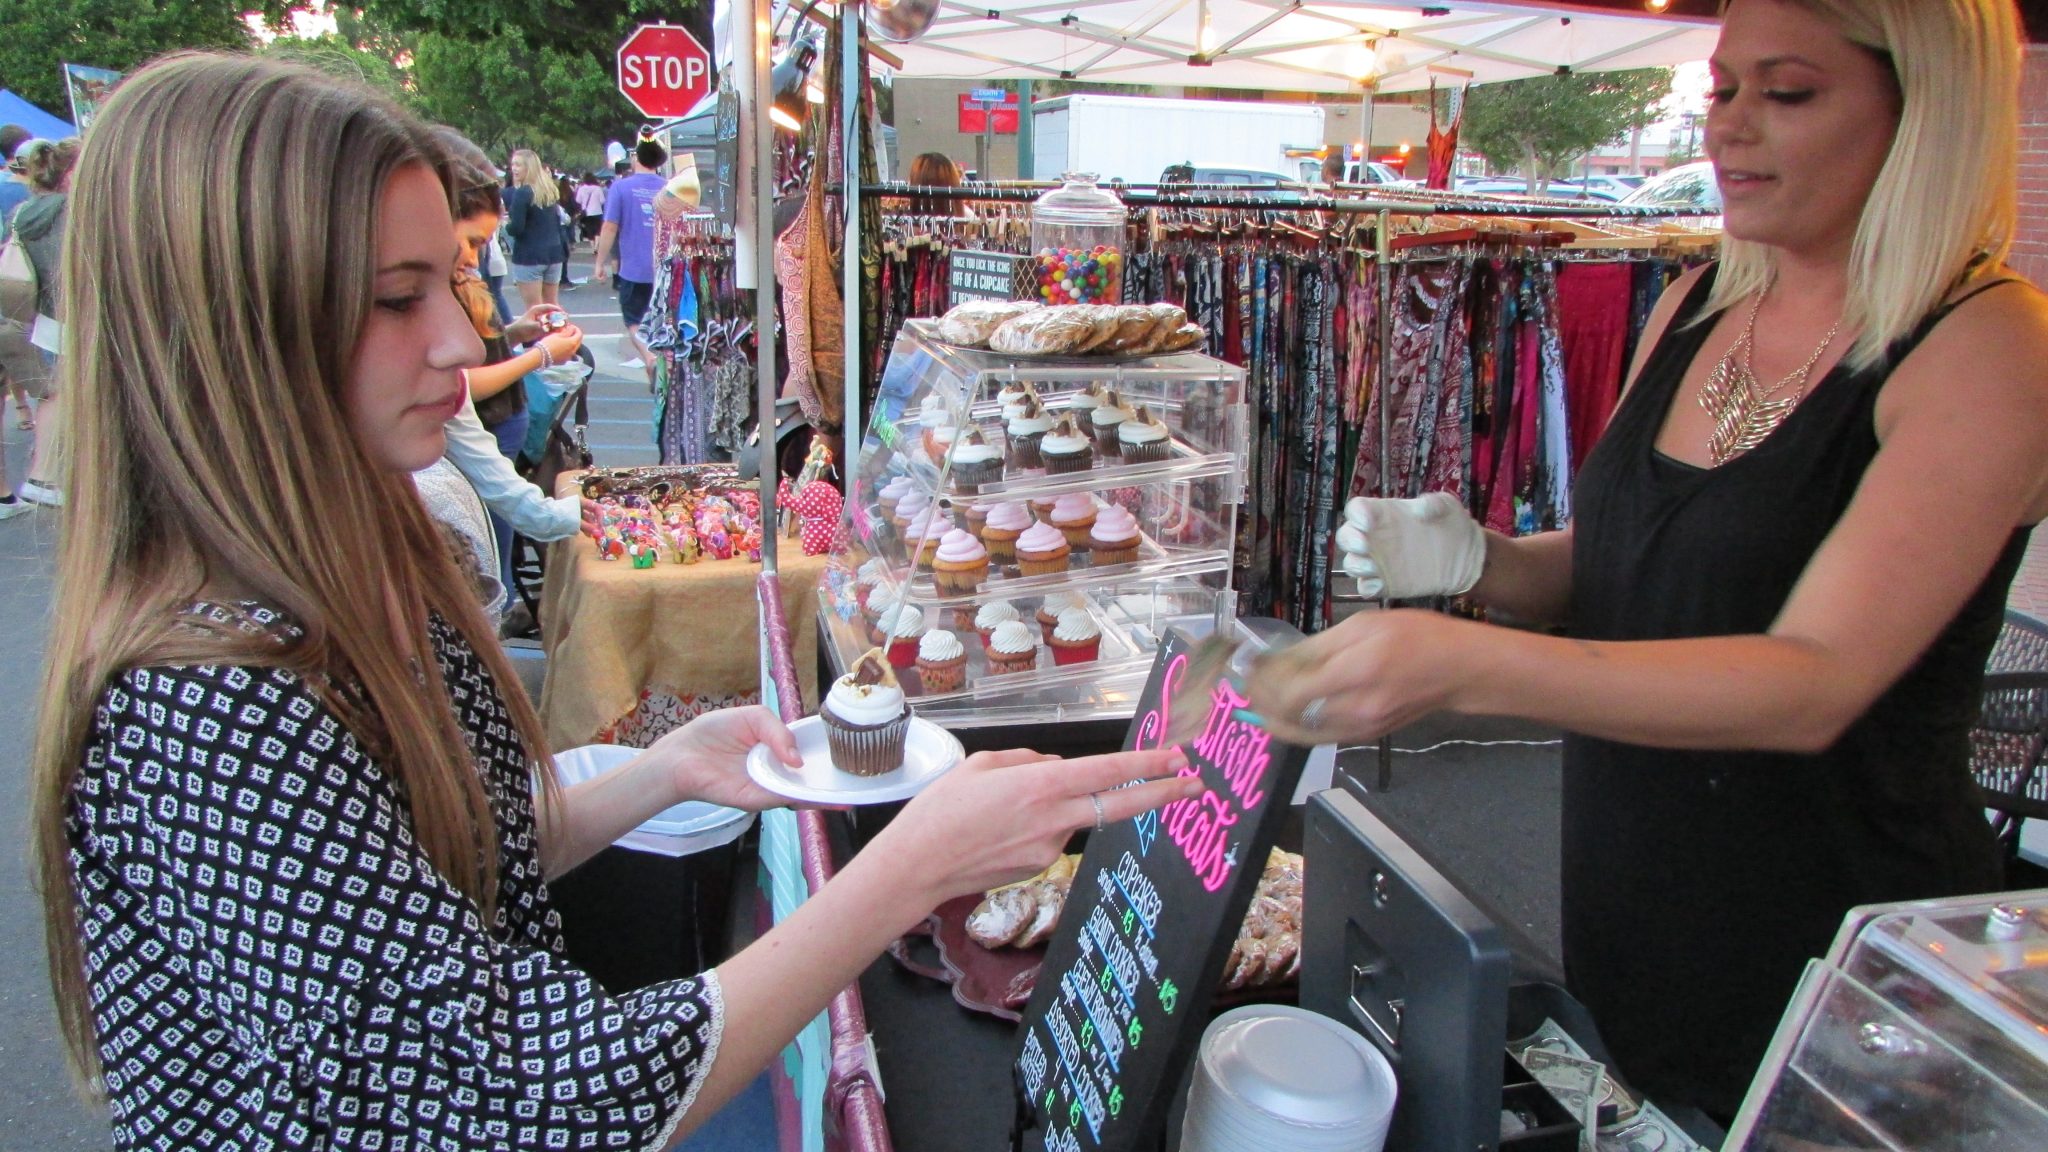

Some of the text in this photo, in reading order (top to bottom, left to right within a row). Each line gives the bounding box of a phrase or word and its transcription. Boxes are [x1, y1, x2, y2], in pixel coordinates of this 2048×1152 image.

[625, 54, 705, 90] STOP
[953, 256, 1010, 274] ONCE YOU LICK THE ICING
[952, 291, 957, 304] IT
[953, 271, 1010, 293] OFF OF A CUPCAKE
[1118, 850, 1162, 930] CUPCAKES
[1088, 903, 1140, 997] GIANT COOKIES
[1091, 988, 1124, 1063] BROWNIES
[1048, 996, 1105, 1134] ASSORTED COOKIES
[1053, 1055, 1063, 1081] 4
[1094, 1051, 1106, 1078] 2
